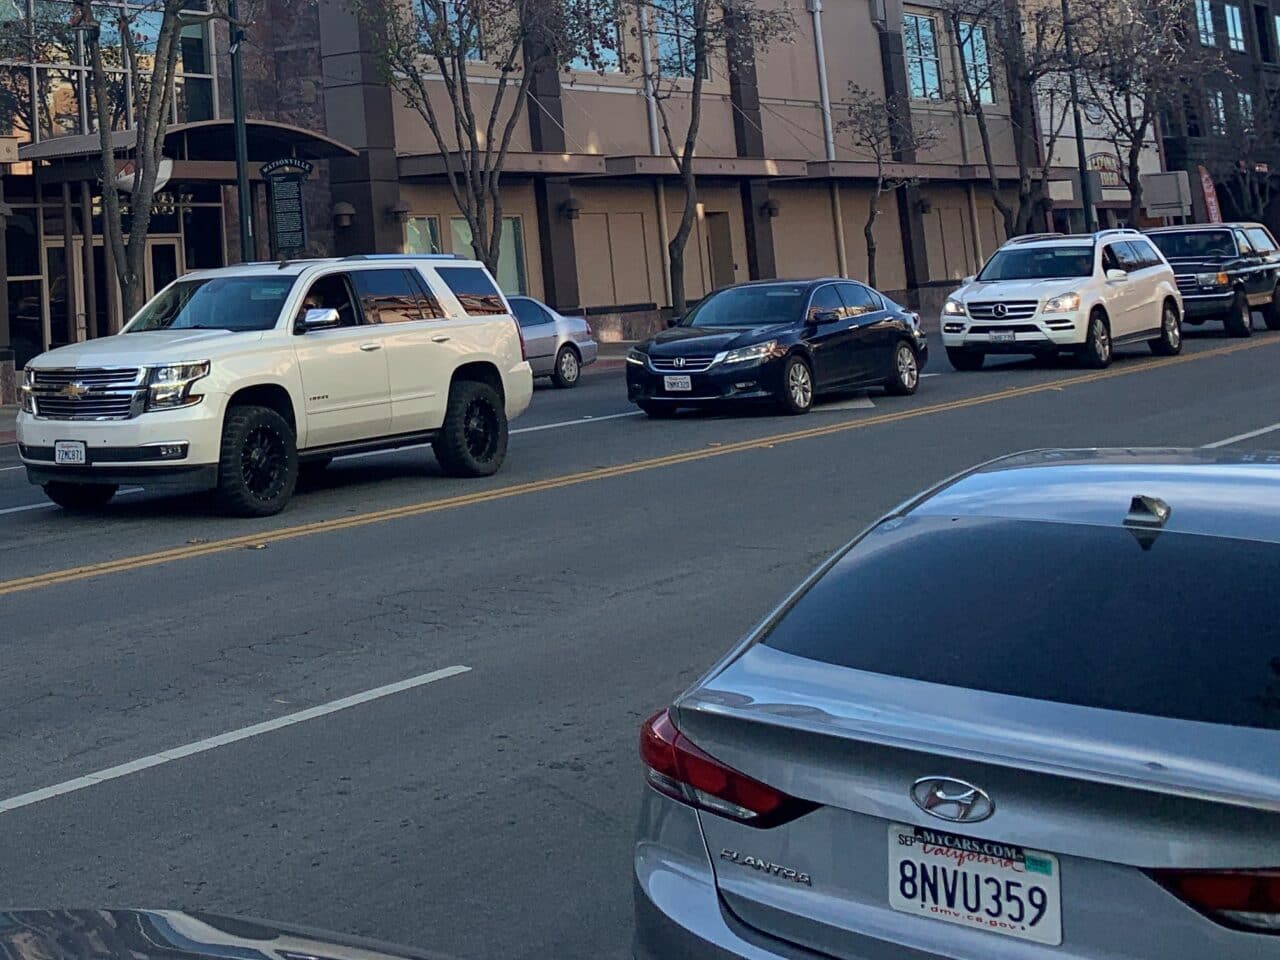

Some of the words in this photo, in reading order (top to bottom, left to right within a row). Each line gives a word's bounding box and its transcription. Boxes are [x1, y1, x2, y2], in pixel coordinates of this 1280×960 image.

[262, 159, 311, 173] WATSONVILLE
[898, 833, 917, 847] SEP
[720, 848, 812, 887] ELANTRA
[899, 859, 1048, 928] 8NVU359
[930, 905, 1017, 931] dmv.ca.gov
